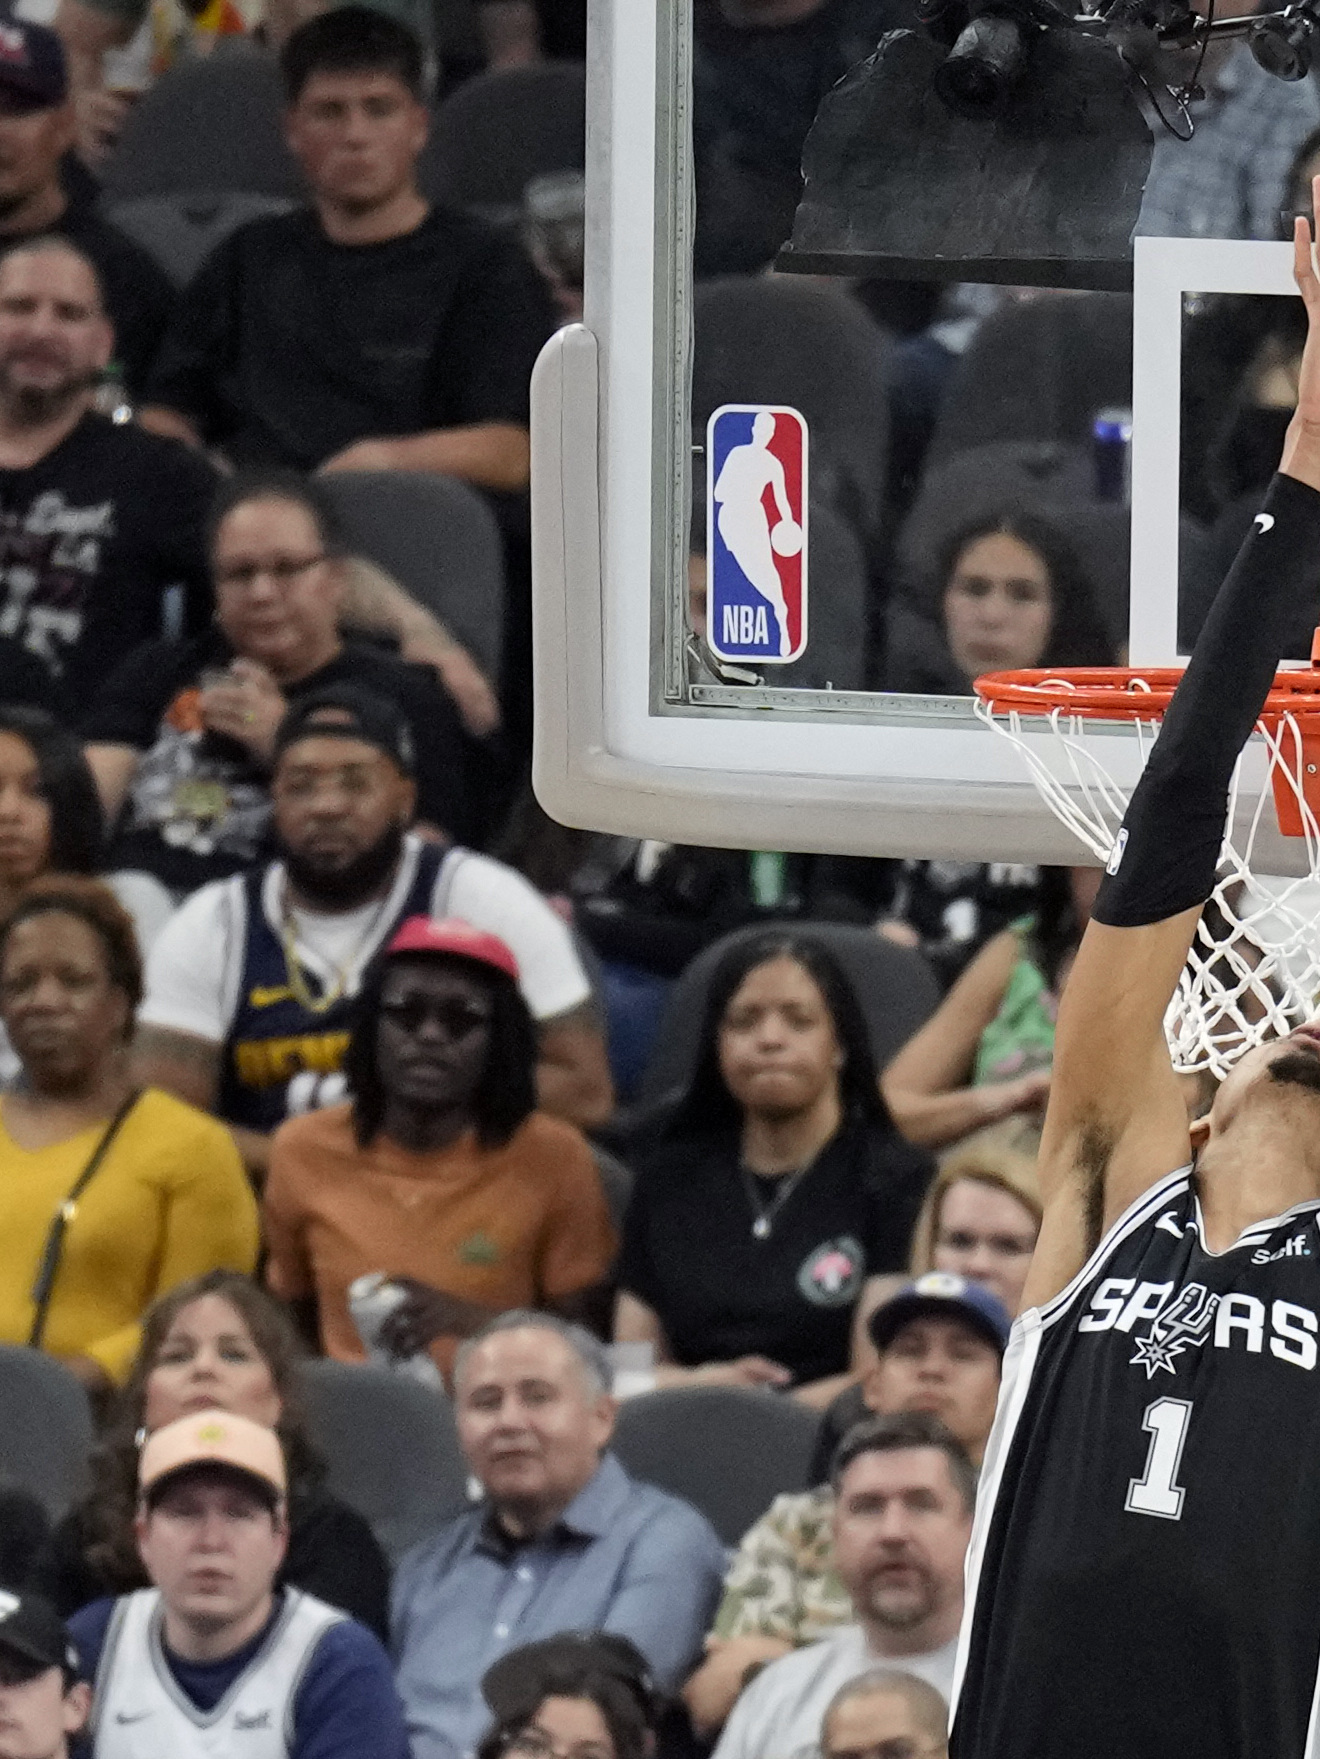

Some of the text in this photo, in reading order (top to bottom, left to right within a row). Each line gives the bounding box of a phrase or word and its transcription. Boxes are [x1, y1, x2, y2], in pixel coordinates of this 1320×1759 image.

[723, 604, 769, 645] NBA
[1079, 1277, 1318, 1379] SPURS
[1124, 1396, 1194, 1521] 1
